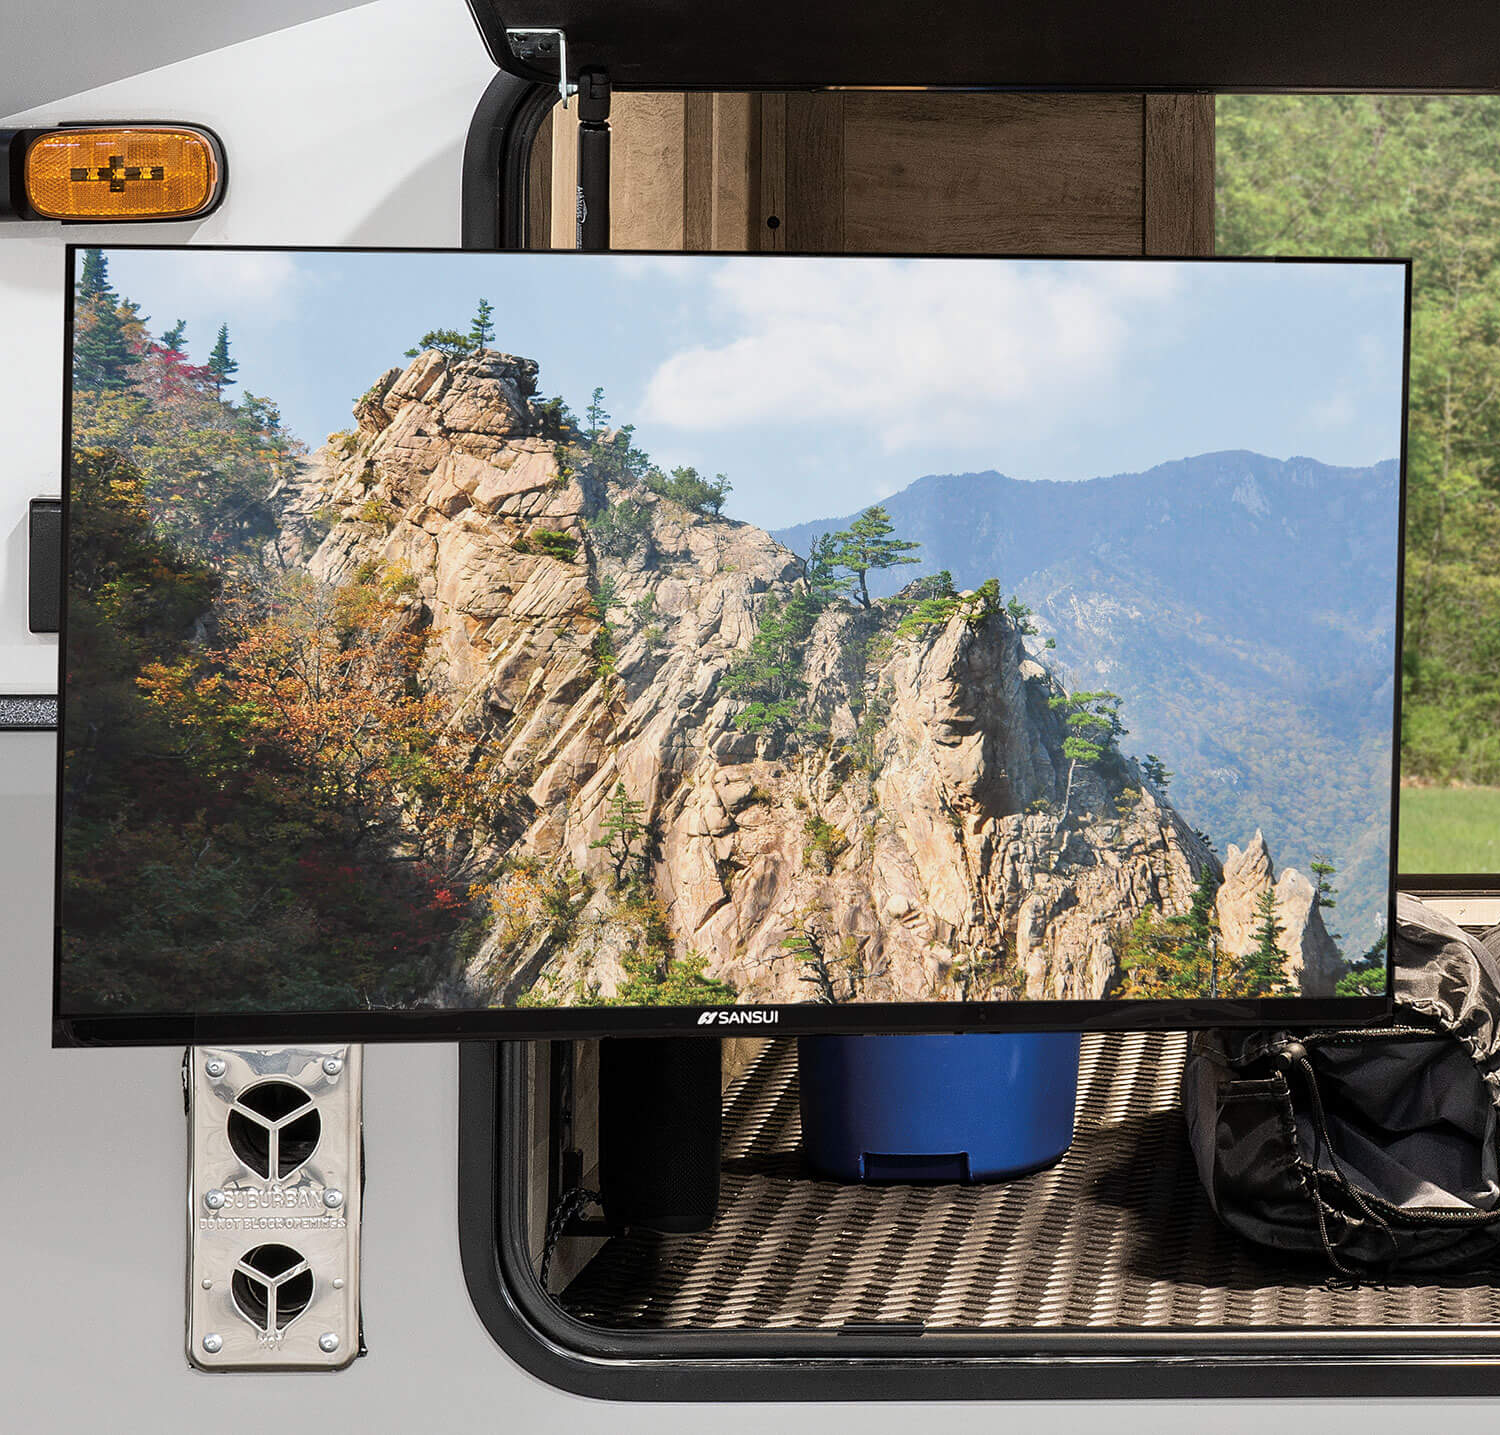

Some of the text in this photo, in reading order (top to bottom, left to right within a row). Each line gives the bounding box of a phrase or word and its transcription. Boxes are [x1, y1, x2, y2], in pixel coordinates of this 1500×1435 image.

[718, 1010, 779, 1024] SANSUI
[223, 1189, 324, 1209] SUBURBAN
[217, 1218, 241, 1230] NOT
